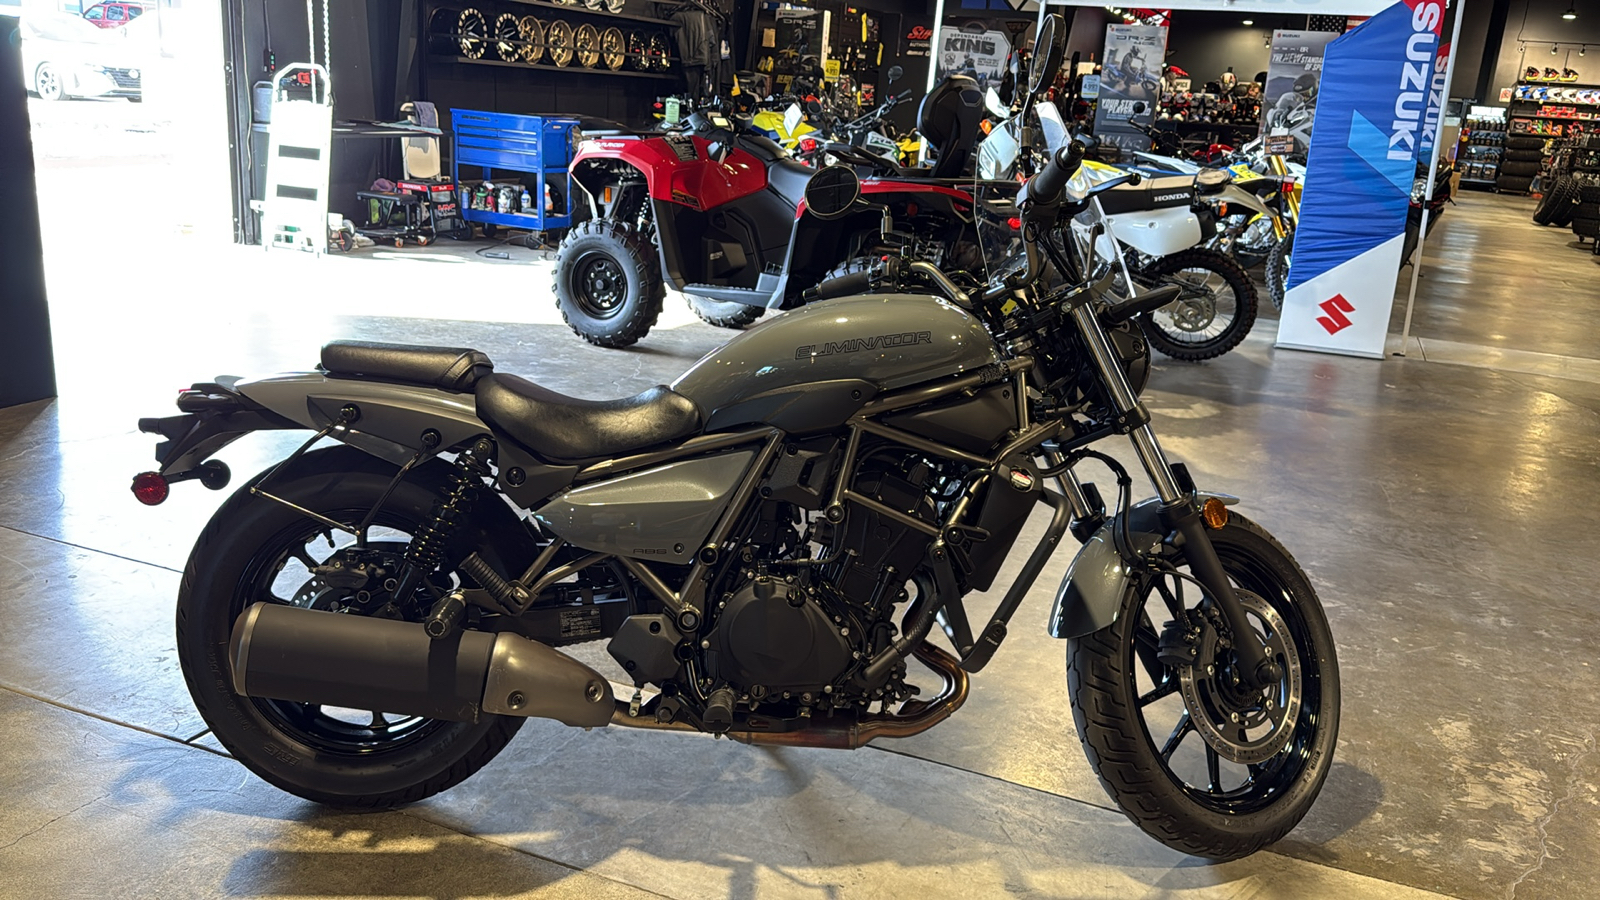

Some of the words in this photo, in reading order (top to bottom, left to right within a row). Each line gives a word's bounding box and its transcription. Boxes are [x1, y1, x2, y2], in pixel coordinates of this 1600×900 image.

[950, 33, 992, 41] DEPENDABILITY
[945, 38, 995, 56] KING
[1300, 56, 1323, 64] STANDA
[1387, 2, 1440, 161] SUZUKI
[1102, 99, 1119, 108] YOUR
[1154, 192, 1191, 202] HONDA
[794, 331, 932, 360] ELIMINATOR
